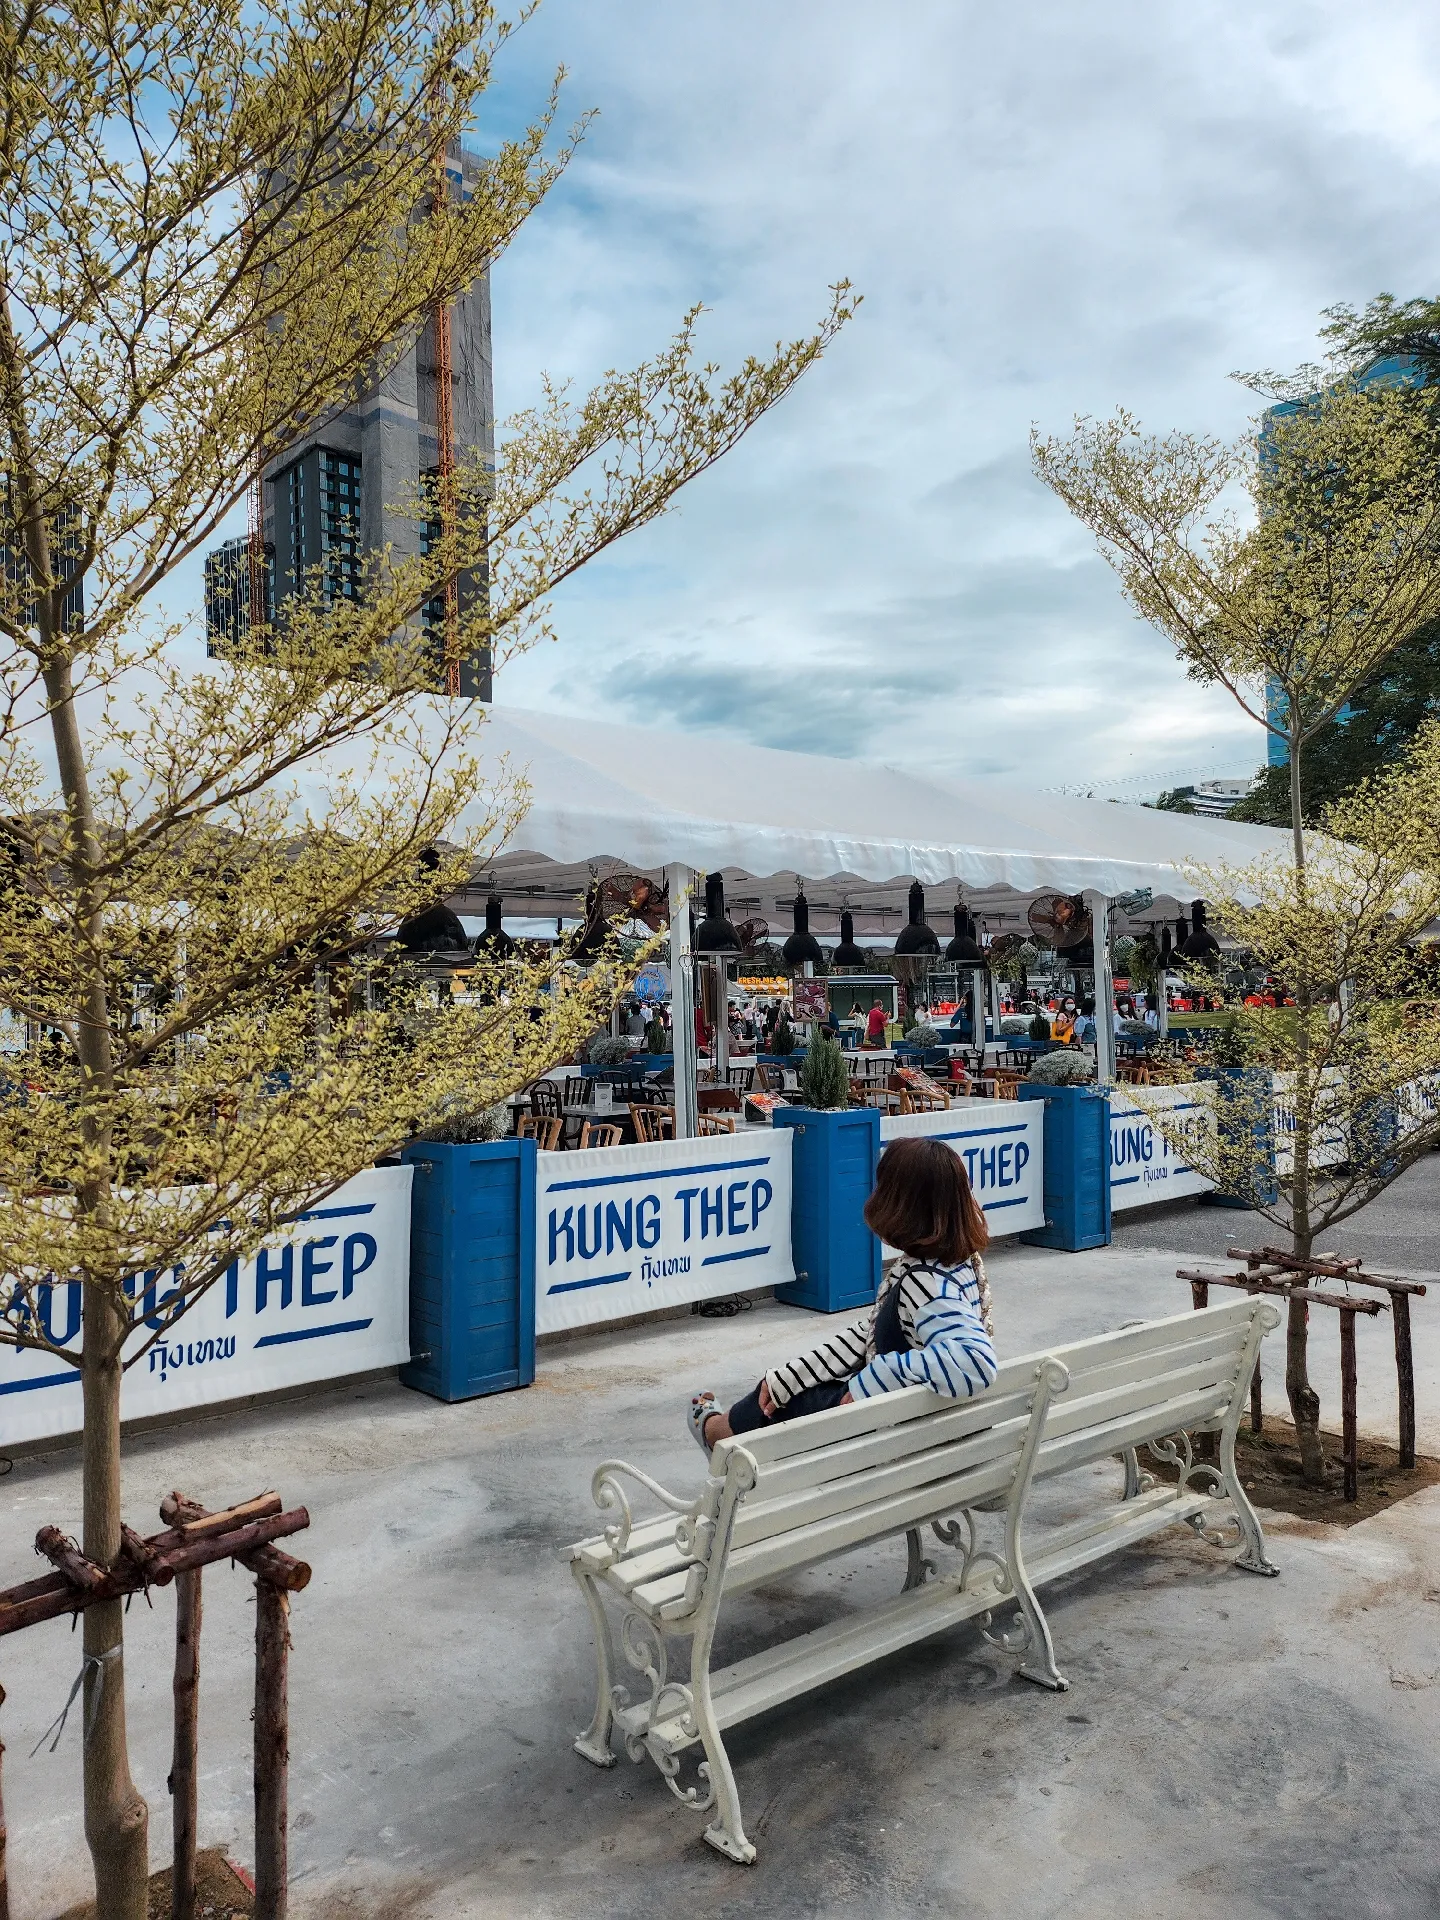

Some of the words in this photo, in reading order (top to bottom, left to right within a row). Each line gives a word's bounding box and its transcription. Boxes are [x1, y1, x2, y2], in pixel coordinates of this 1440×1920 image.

[737, 976, 761, 985] FRESH
[963, 1141, 1029, 1190] THEP
[548, 1194, 661, 1266] KUNG
[674, 1178, 773, 1243] THEP
[640, 1255, 691, 1288] กุ้งเทพ
[0, 1253, 187, 1354] UG
